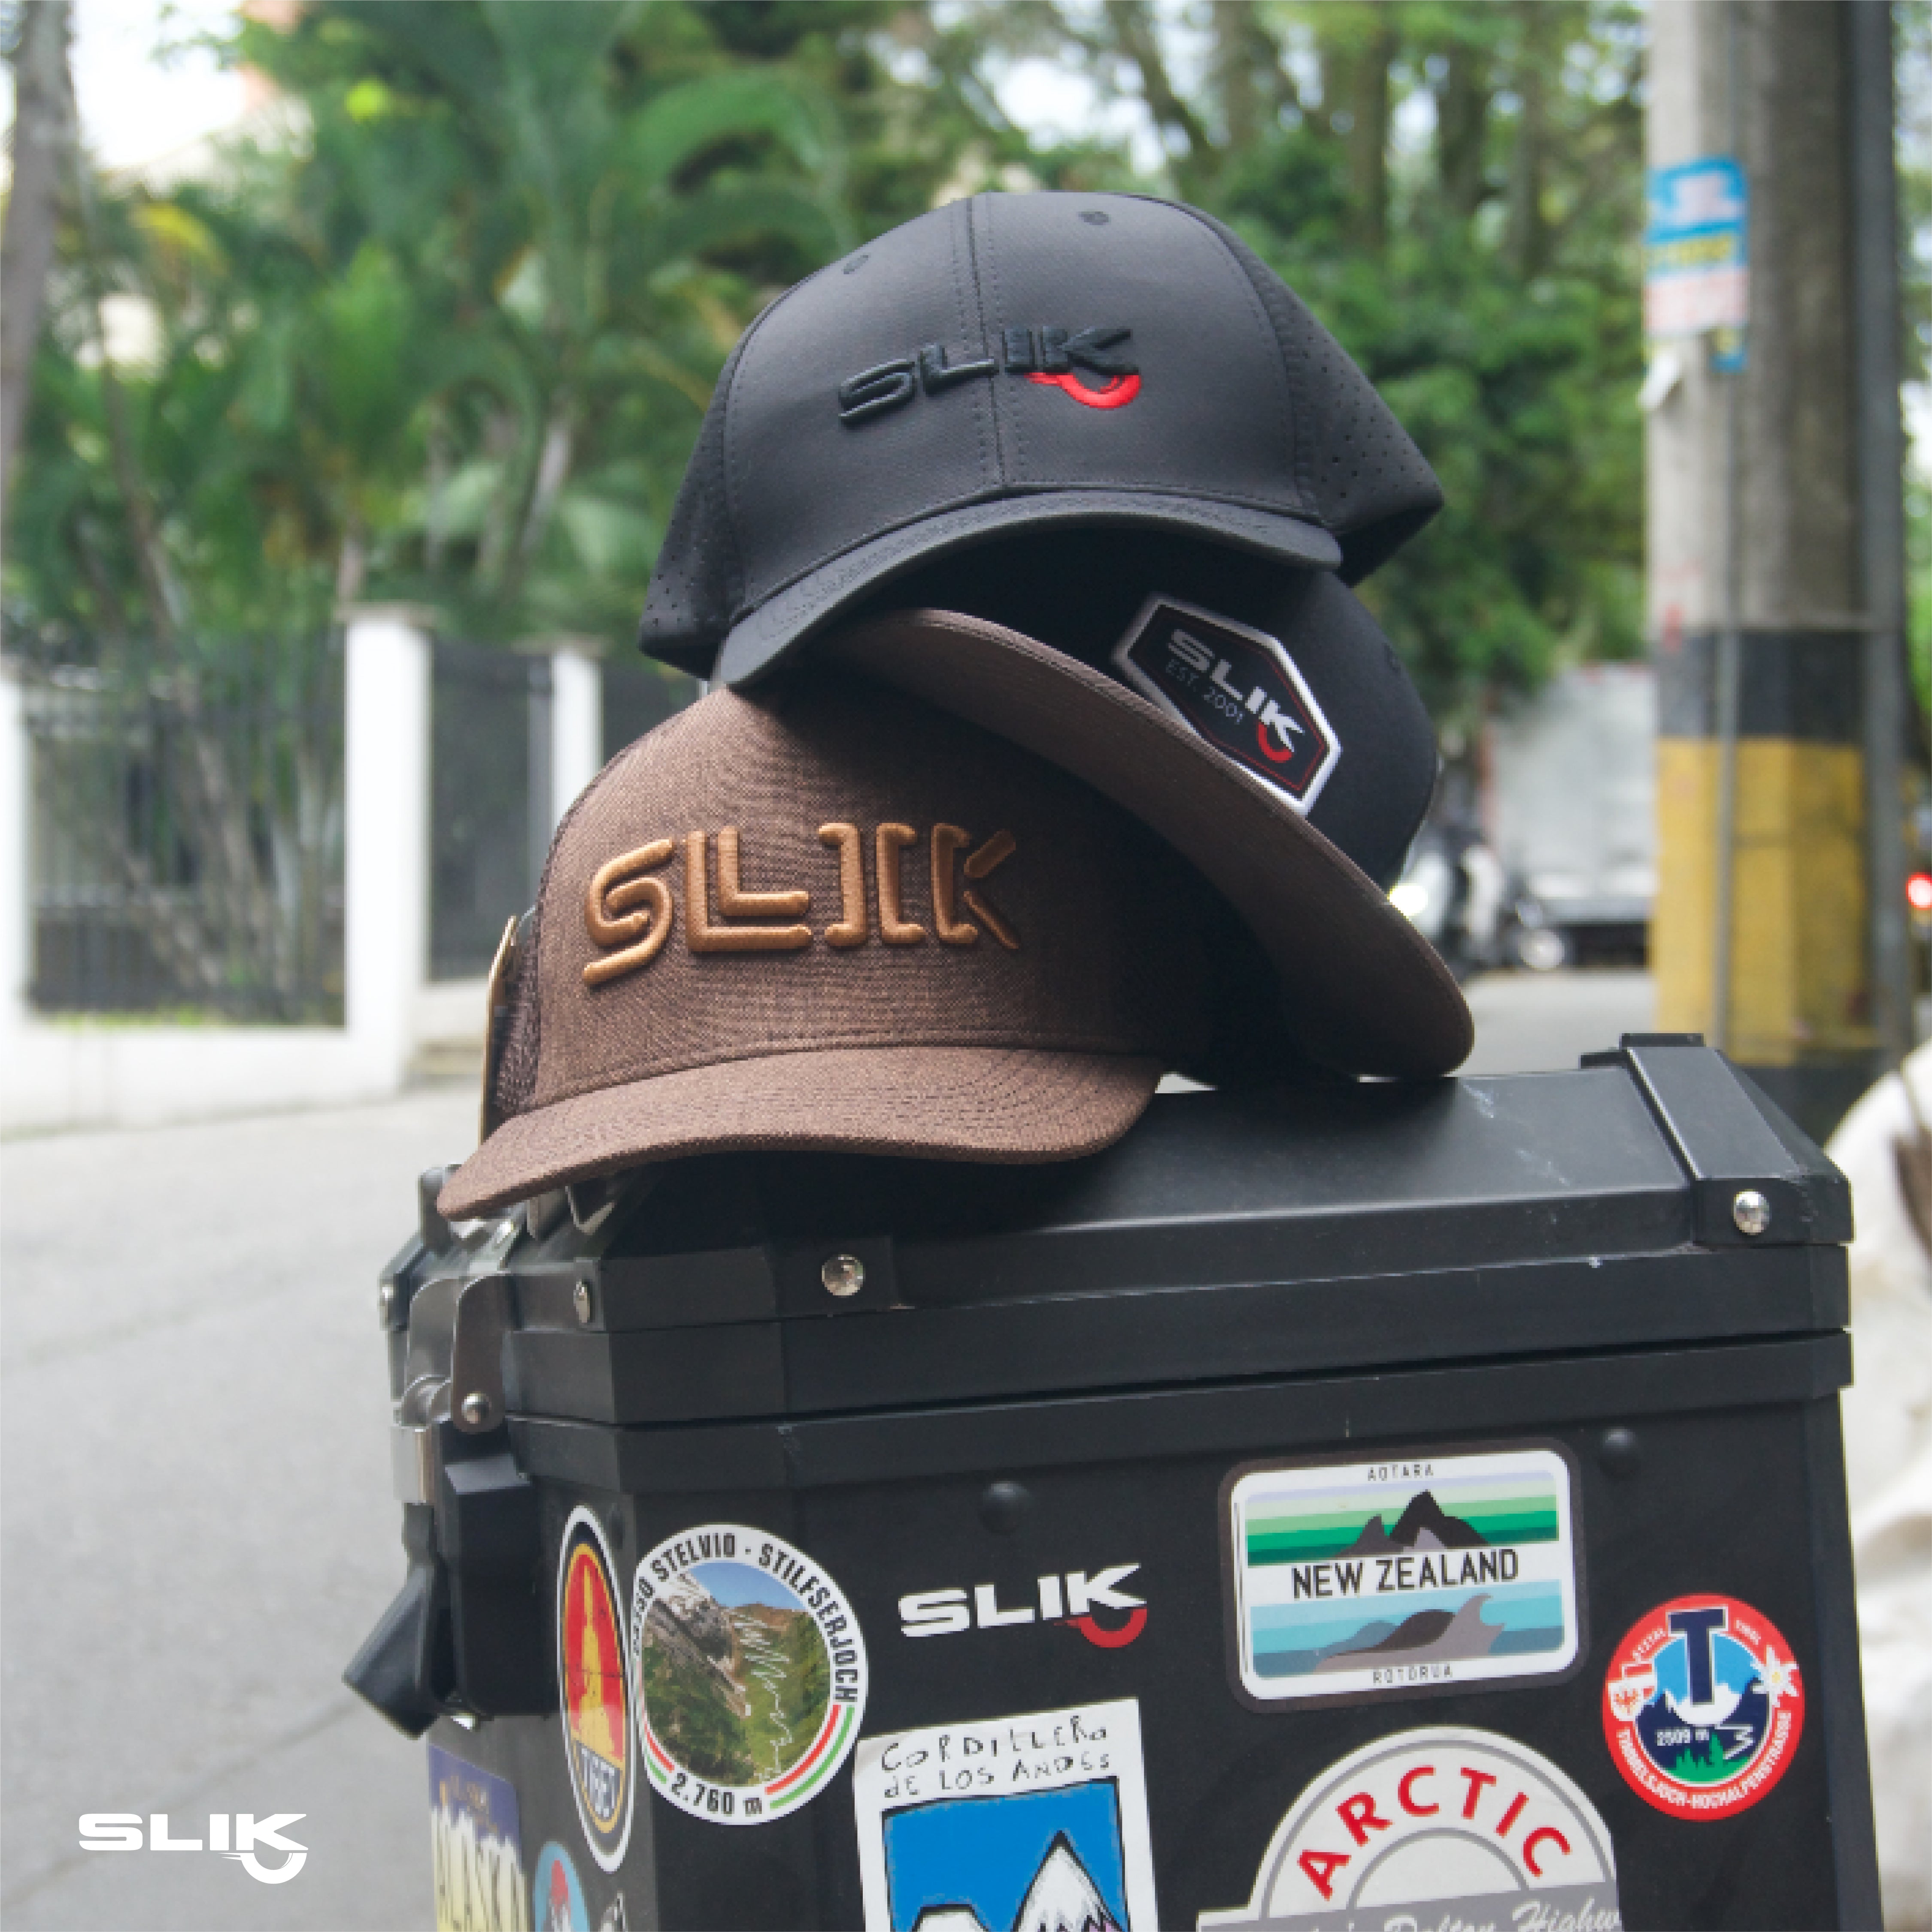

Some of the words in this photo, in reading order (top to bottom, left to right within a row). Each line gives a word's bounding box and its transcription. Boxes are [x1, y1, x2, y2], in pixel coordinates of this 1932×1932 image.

[839, 325, 1140, 426] SLIK
[1166, 629, 1305, 754] SLIK
[1202, 687, 1246, 725] 2001
[583, 822, 1019, 985] SLIK
[898, 1562, 1147, 1638] SLIK
[1292, 1560, 1364, 1600] NEW
[1375, 1548, 1520, 1592] ZEALAND
[649, 1533, 736, 1580] STELVIO
[758, 1542, 858, 1702] STILFSERJOCH
[1373, 1664, 1453, 1686] ROTORUA
[670, 1772, 736, 1815] 2.760
[744, 1797, 762, 1815] m
[939, 1767, 995, 1790] LOS
[1012, 1751, 1110, 1782] ANDES
[1296, 1765, 1571, 1902] ARCTIC
